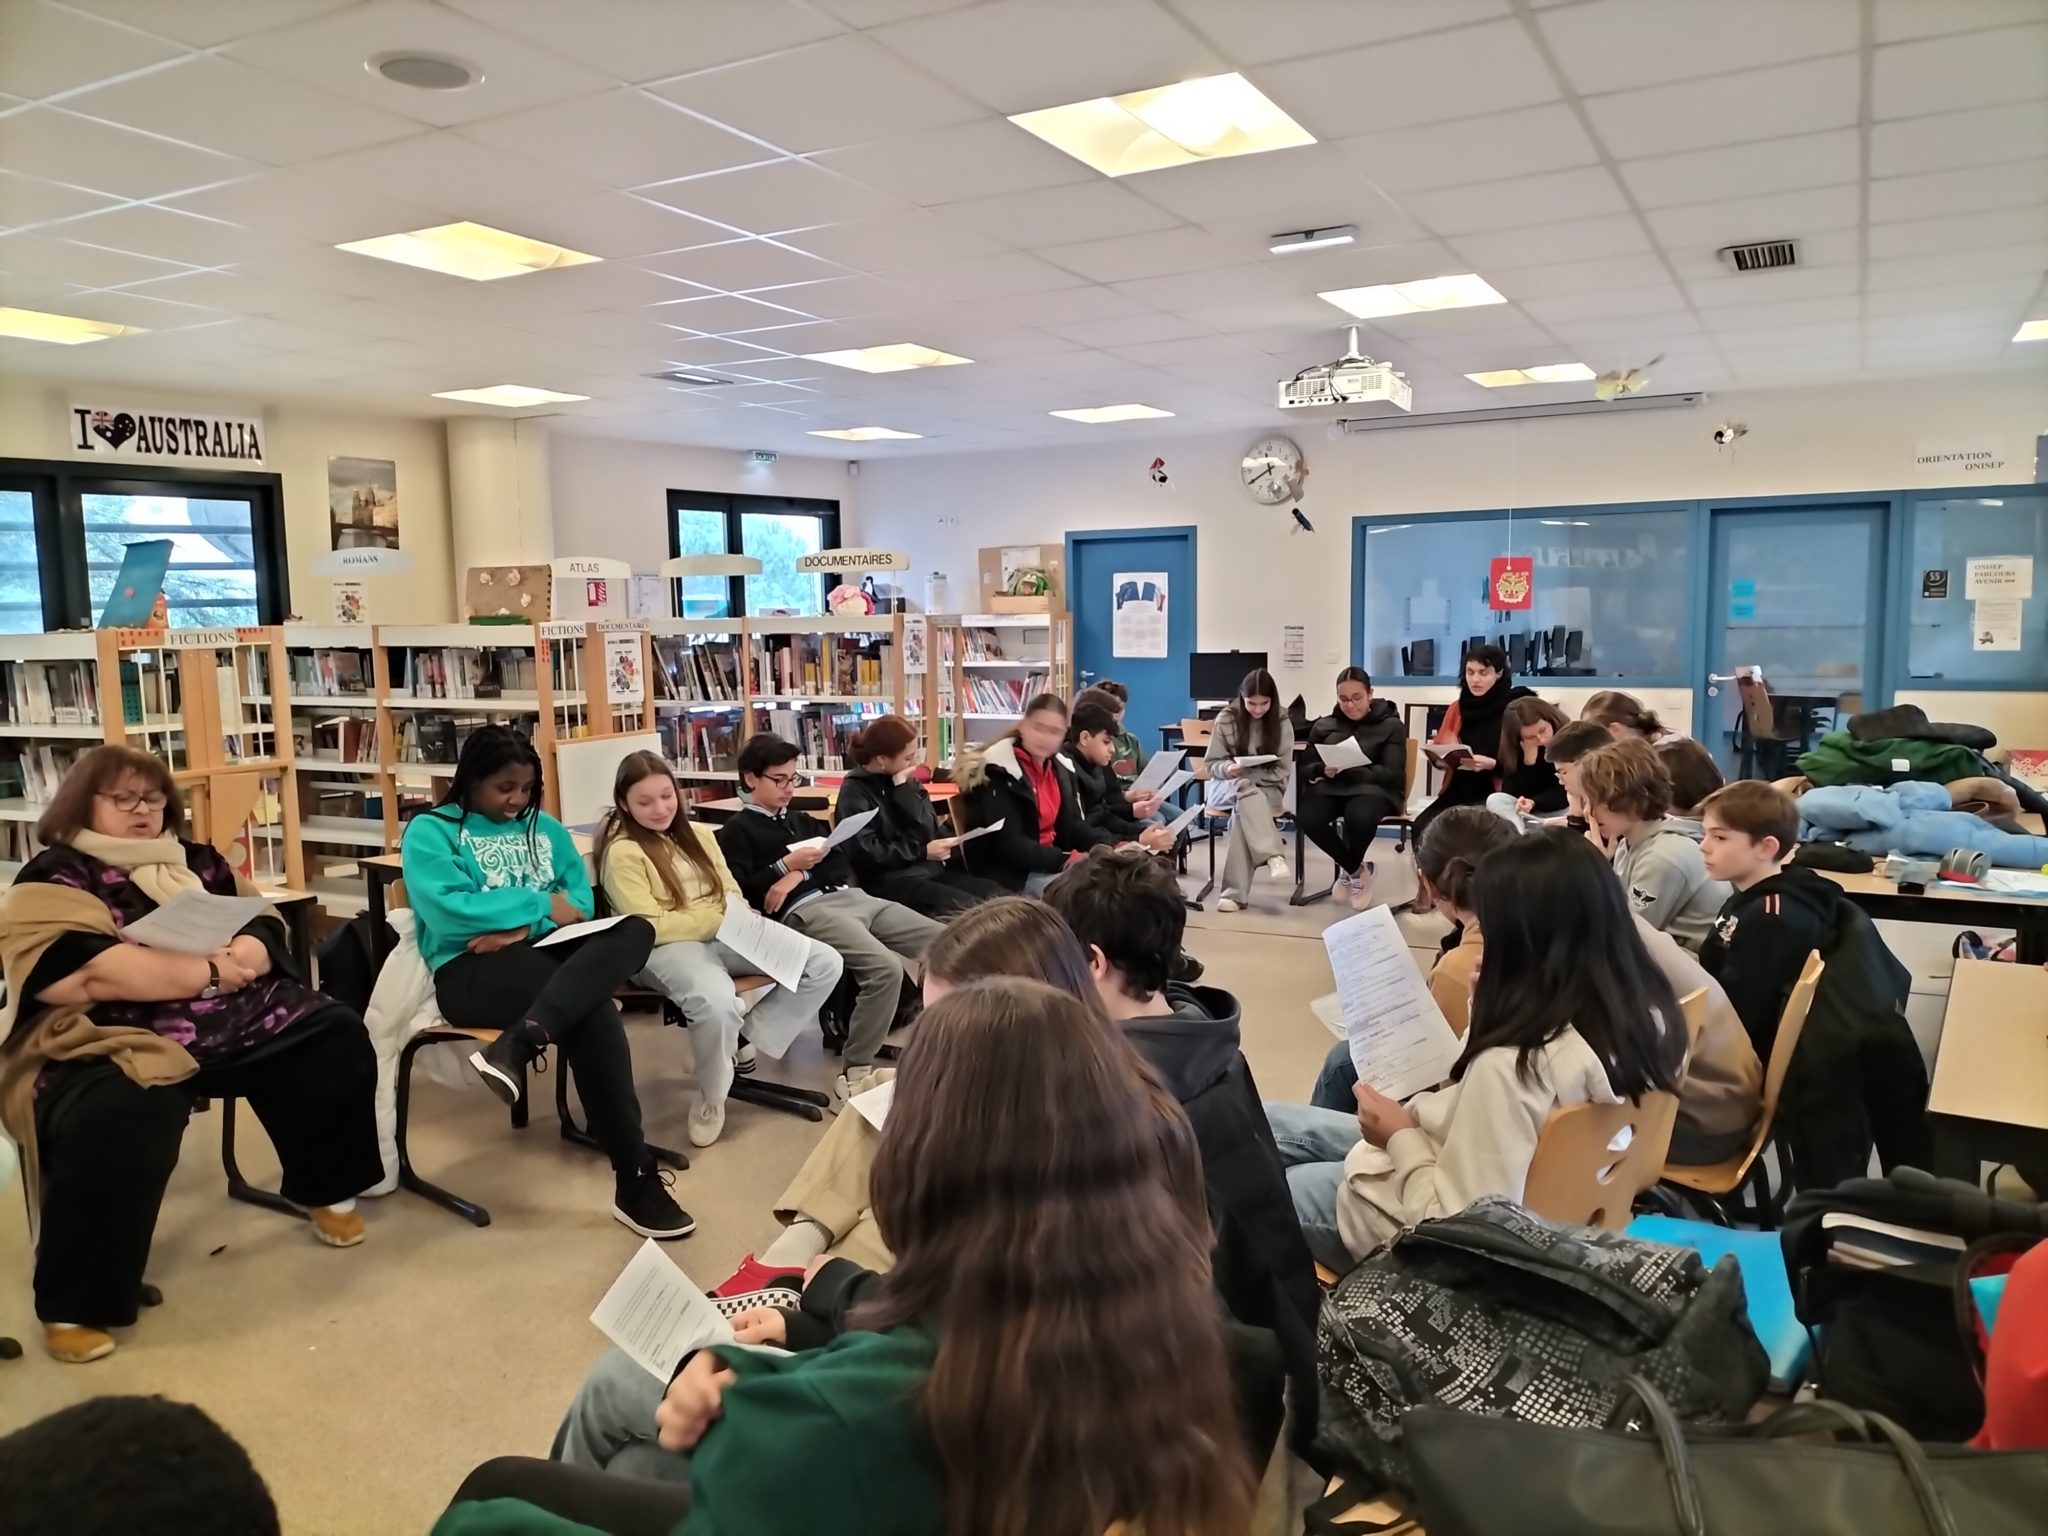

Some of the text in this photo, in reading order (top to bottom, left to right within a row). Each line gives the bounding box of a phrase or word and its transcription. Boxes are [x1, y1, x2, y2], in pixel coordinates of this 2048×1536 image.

[74, 408, 262, 460] I AUSTRALIA
[1917, 451, 1992, 464] ORIENTATION
[1965, 461, 2004, 471] ONISEP
[342, 555, 379, 565] ROMANS
[569, 563, 600, 573] ATLAS
[541, 624, 585, 635] FICTIONS
[598, 622, 649, 630] DOCUMENTAIRES
[170, 632, 235, 645] FICTIONS
